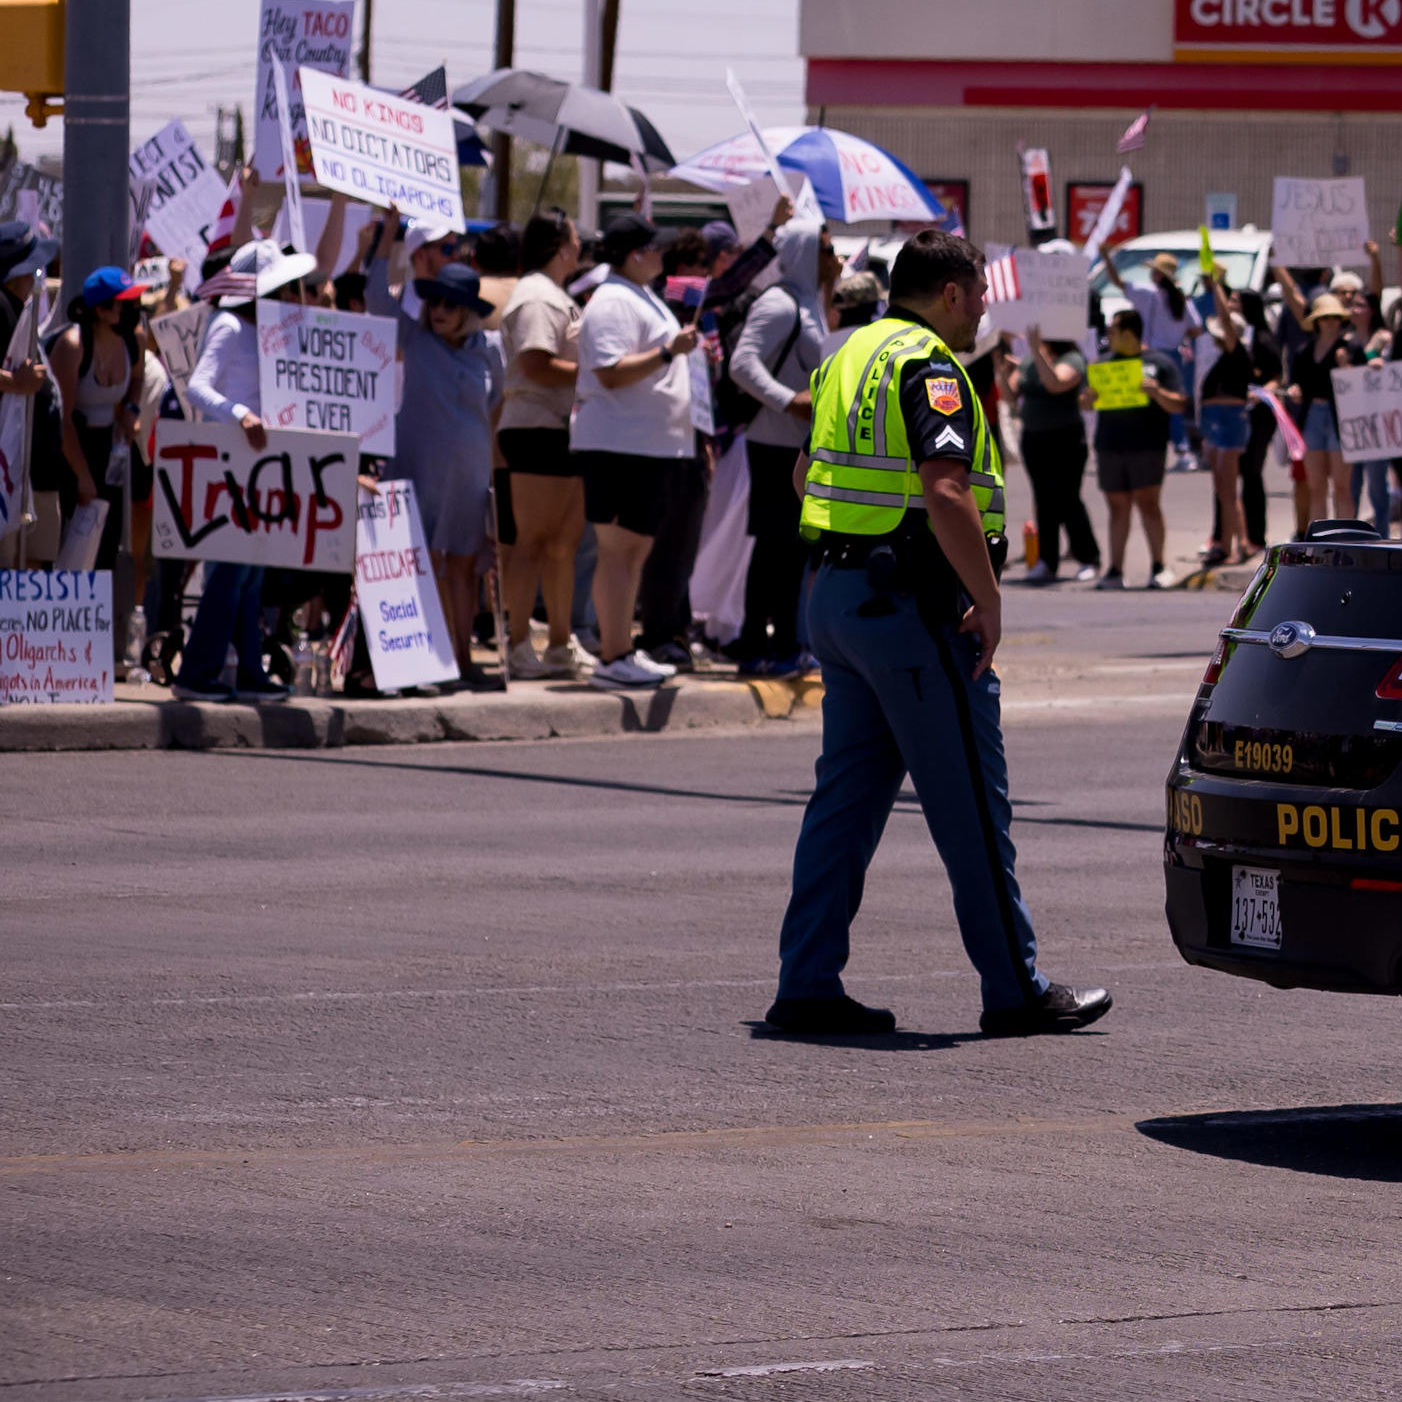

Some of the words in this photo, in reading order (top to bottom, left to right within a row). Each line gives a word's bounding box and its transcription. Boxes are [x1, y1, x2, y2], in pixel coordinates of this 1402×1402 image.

[263, 7, 297, 44] Hey
[303, 10, 348, 38] TACO
[295, 40, 346, 66] Country
[331, 88, 356, 113] NO
[364, 101, 424, 134] KINGS
[312, 116, 337, 144] NO
[343, 127, 452, 183] DICTATORS
[322, 158, 346, 181] NO
[352, 166, 454, 218] OLIGARCHS
[275, 358, 379, 402] PRESIDENT
[859, 340, 905, 441] POLICE
[305, 399, 351, 432] EVER
[0, 567, 97, 601] RESIST!
[26, 610, 48, 632] NO
[52, 607, 92, 632] PLACE
[95, 603, 111, 632] for
[380, 596, 418, 623] Social
[6, 633, 77, 670] Oligarchs
[379, 630, 433, 654] Security
[1272, 626, 1292, 644] Ford
[30, 674, 41, 690] in
[1234, 739, 1294, 773] E19039
[1250, 874, 1275, 890] TEXAS
